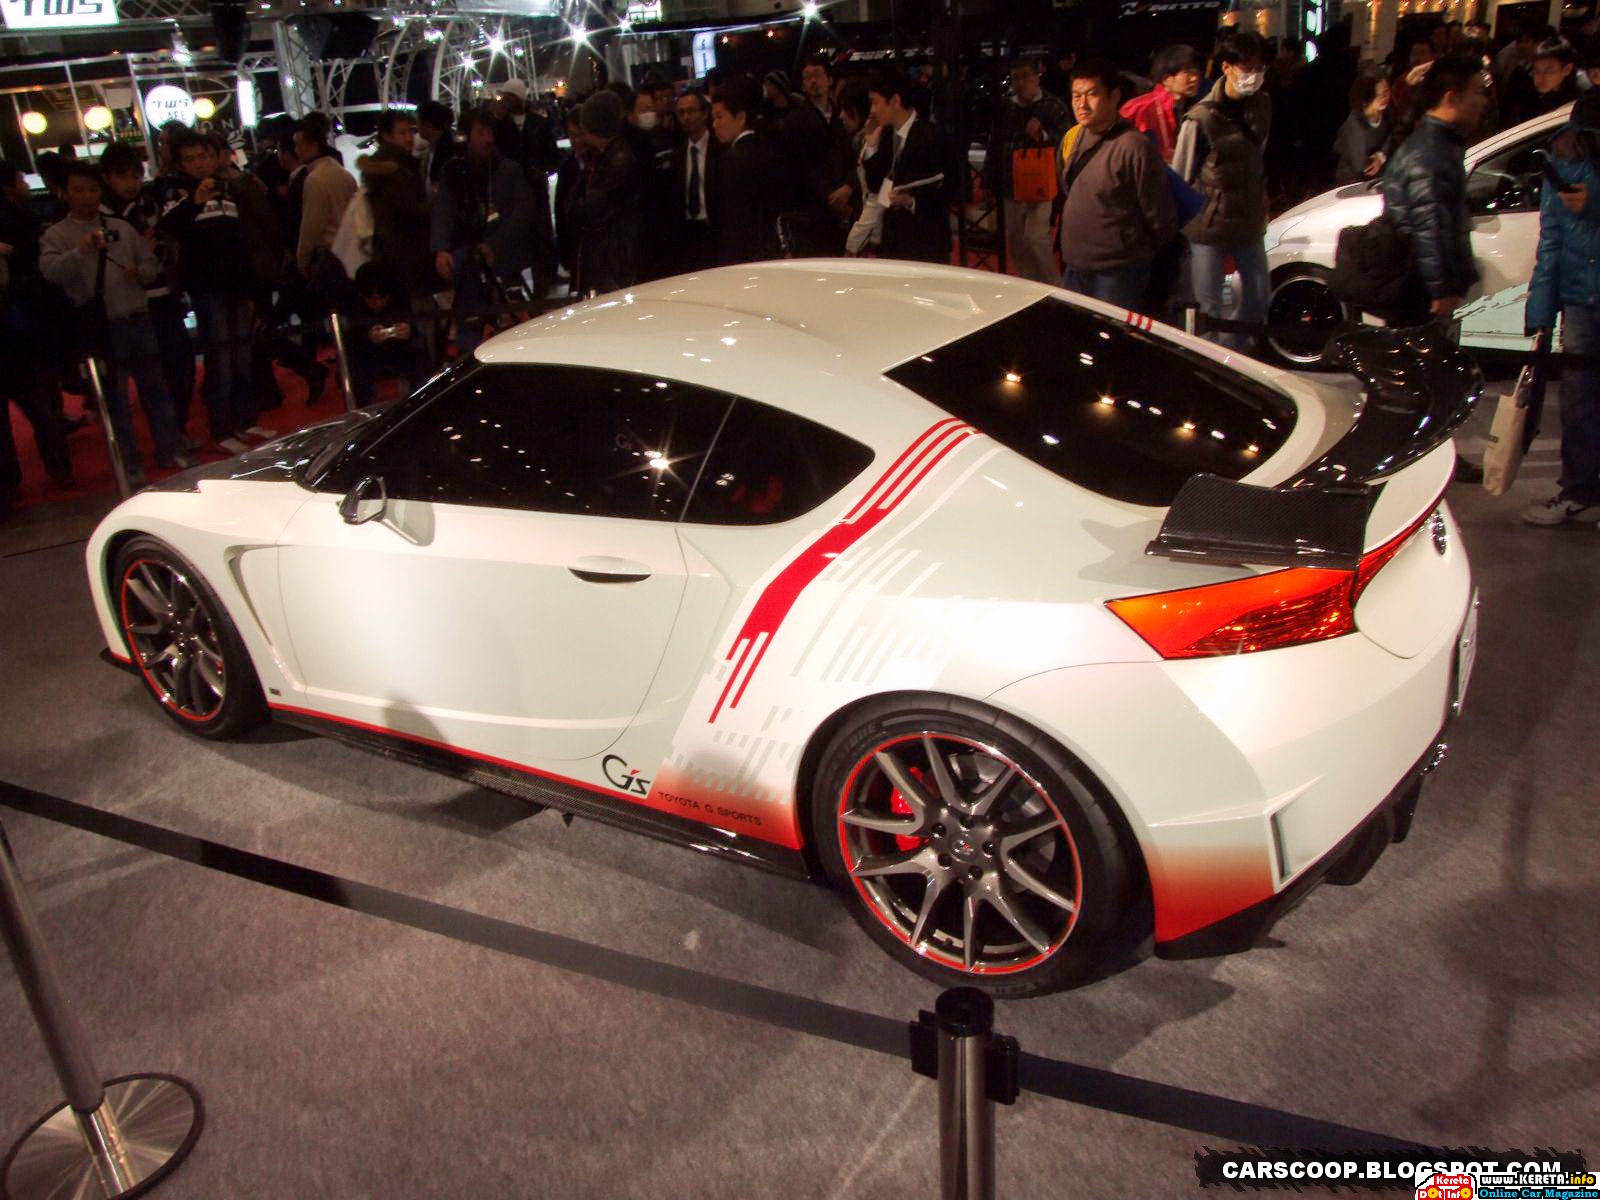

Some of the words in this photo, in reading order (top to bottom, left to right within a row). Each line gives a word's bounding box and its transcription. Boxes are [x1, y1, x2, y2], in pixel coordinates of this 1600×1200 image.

[657, 791, 700, 810] TOYOTA
[704, 803, 714, 814] G
[717, 807, 763, 827] SPORTS
